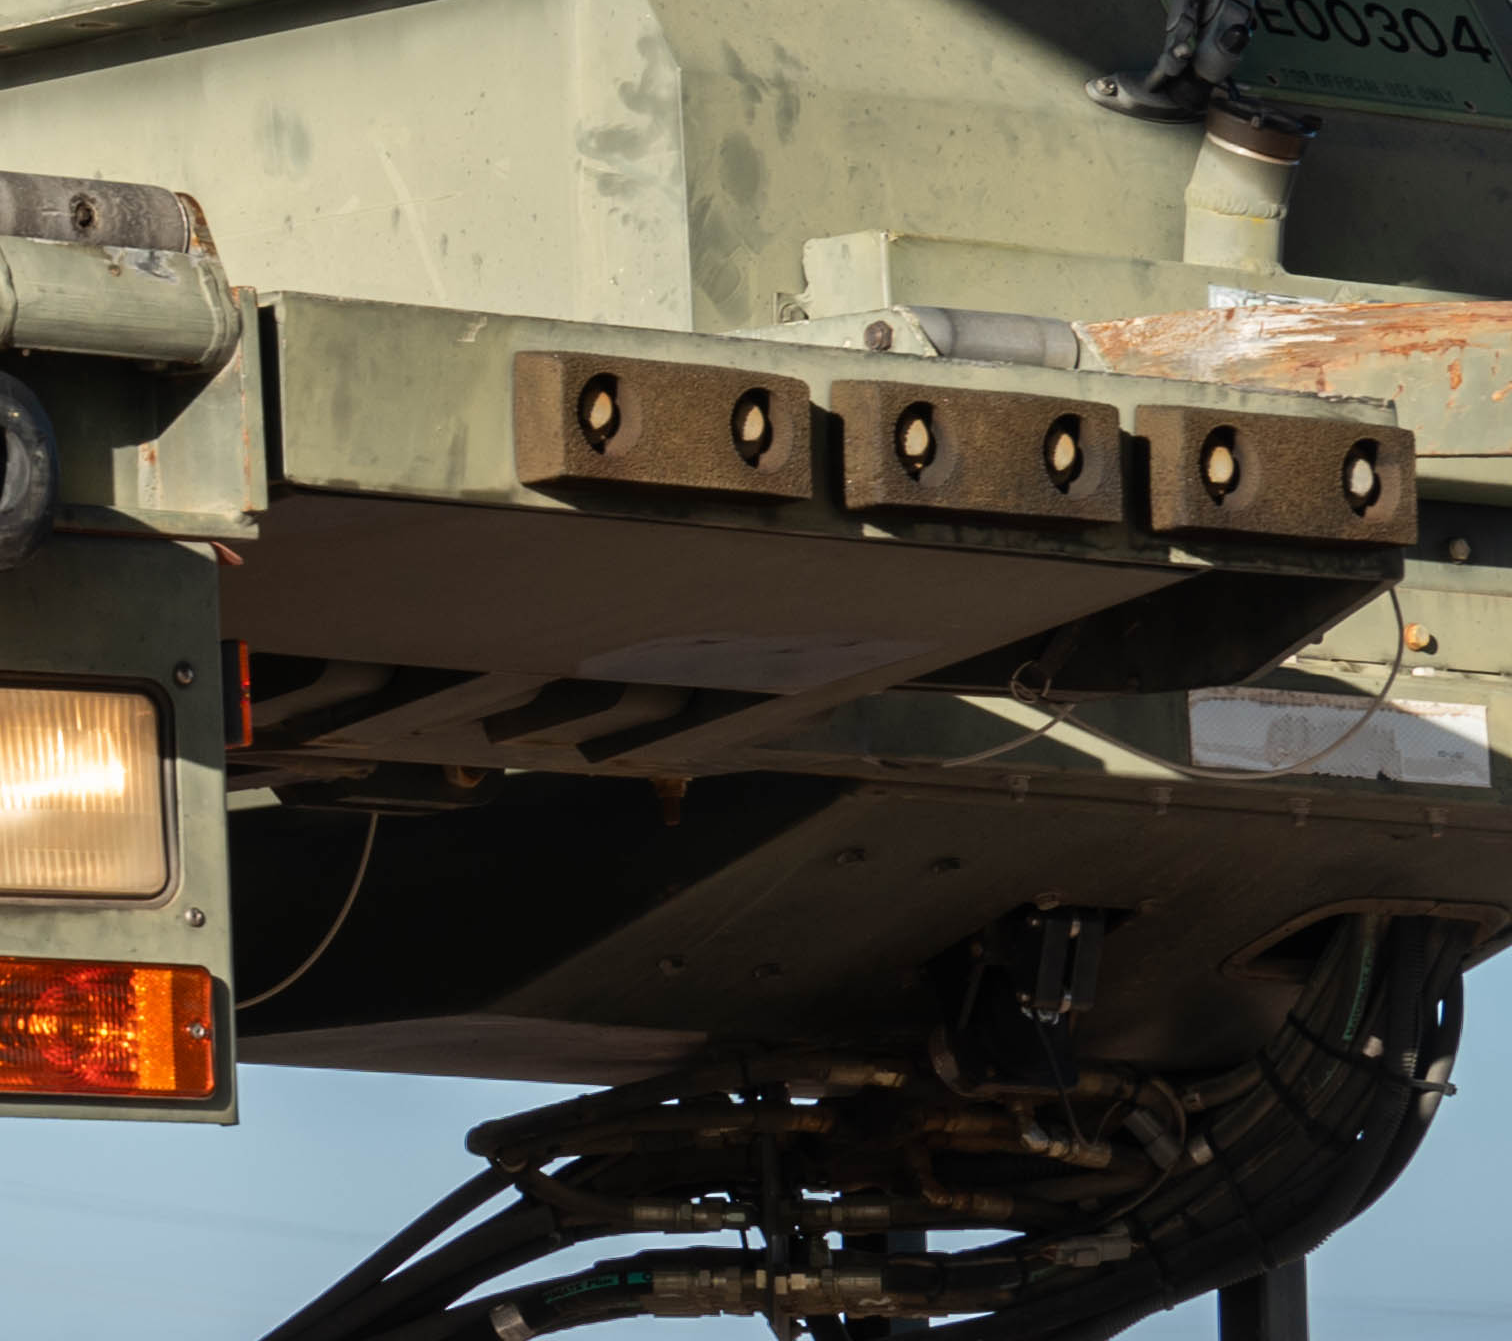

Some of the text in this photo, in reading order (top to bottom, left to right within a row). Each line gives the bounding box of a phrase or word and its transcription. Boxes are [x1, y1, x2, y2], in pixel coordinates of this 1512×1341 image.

[1279, 67, 1455, 105] FOR OFFICIAL USE ONLY
